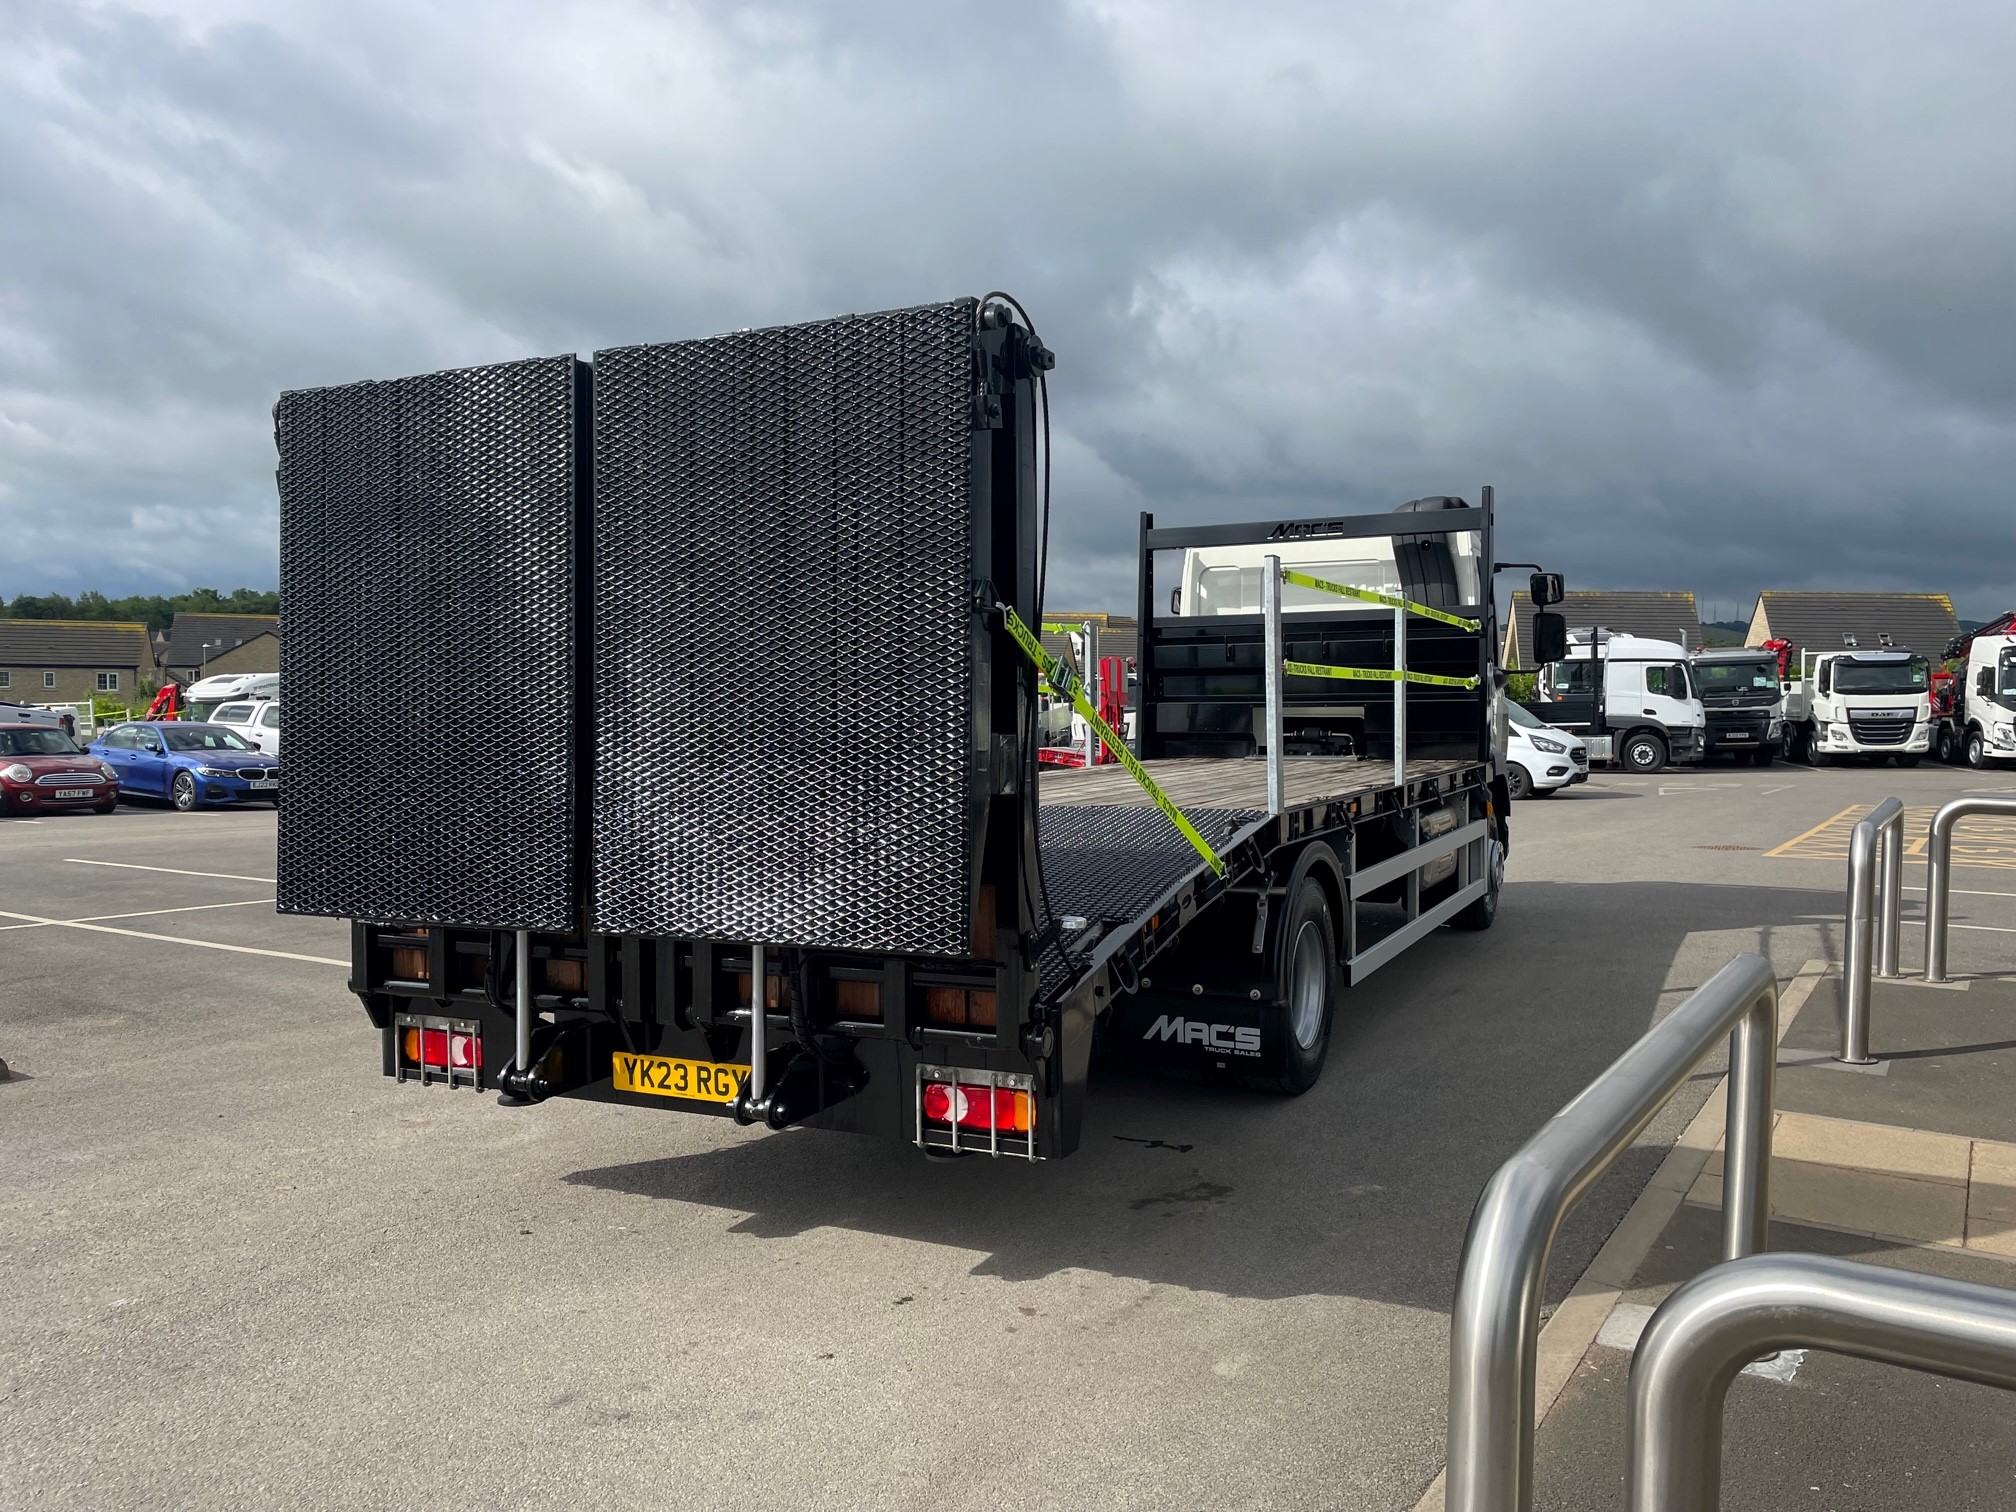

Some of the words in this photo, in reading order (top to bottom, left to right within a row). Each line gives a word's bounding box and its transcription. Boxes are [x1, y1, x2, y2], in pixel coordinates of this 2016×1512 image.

[1124, 752, 1139, 776] FALL
[1138, 768, 1161, 802] TRUCKS
[1203, 1046, 1232, 1055] TRUCK
[1233, 1049, 1262, 1058] SALES
[623, 1057, 689, 1092] YK23
[696, 1065, 748, 1097] RGY
